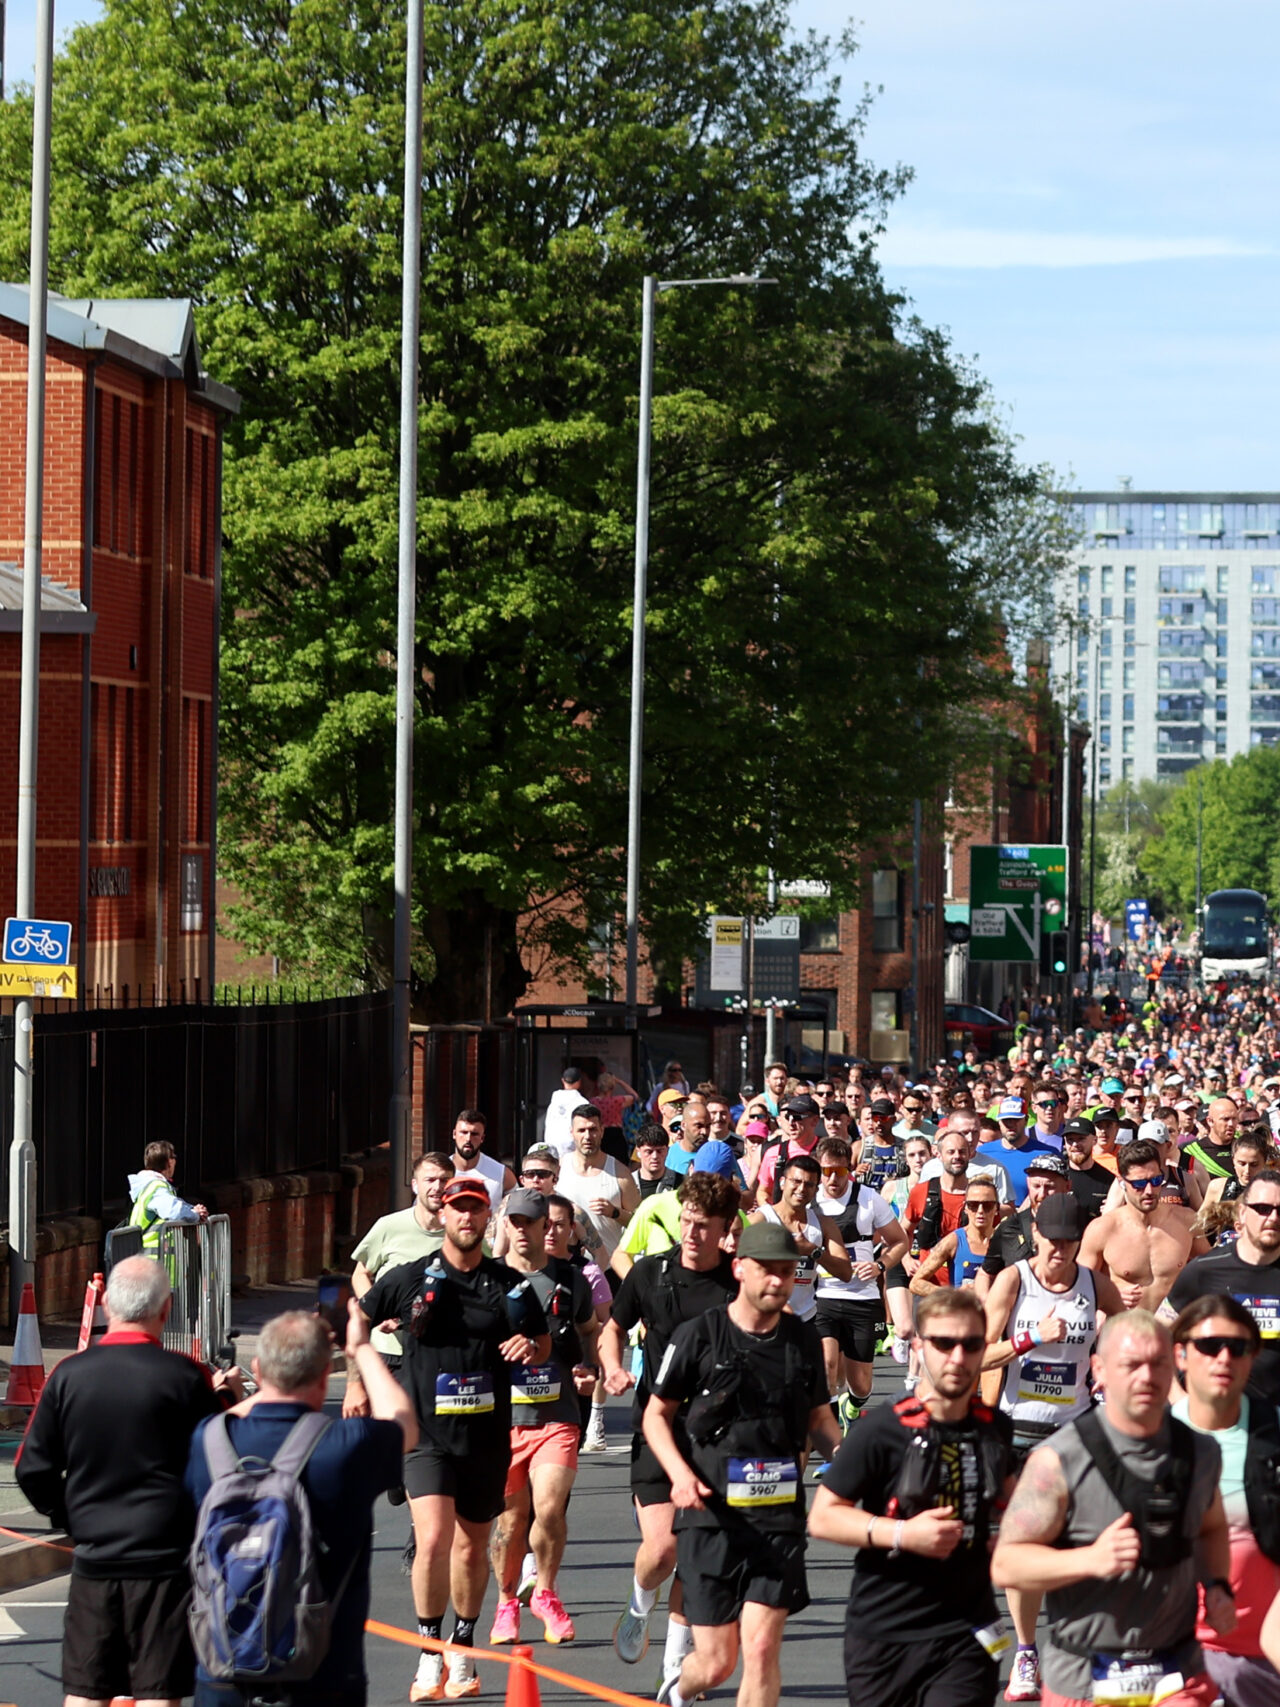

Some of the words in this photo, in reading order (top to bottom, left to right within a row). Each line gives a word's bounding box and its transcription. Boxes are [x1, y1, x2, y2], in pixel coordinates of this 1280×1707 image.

[526, 1375, 550, 1384] ROSS
[1035, 1373, 1063, 1384] JULIA
[458, 1385, 476, 1395] LEE
[526, 1386, 550, 1395] 11670
[1033, 1384, 1063, 1396] 11790
[453, 1397, 481, 1406] 11886
[745, 1471, 782, 1482] CRAIG
[749, 1484, 778, 1496] 3967
